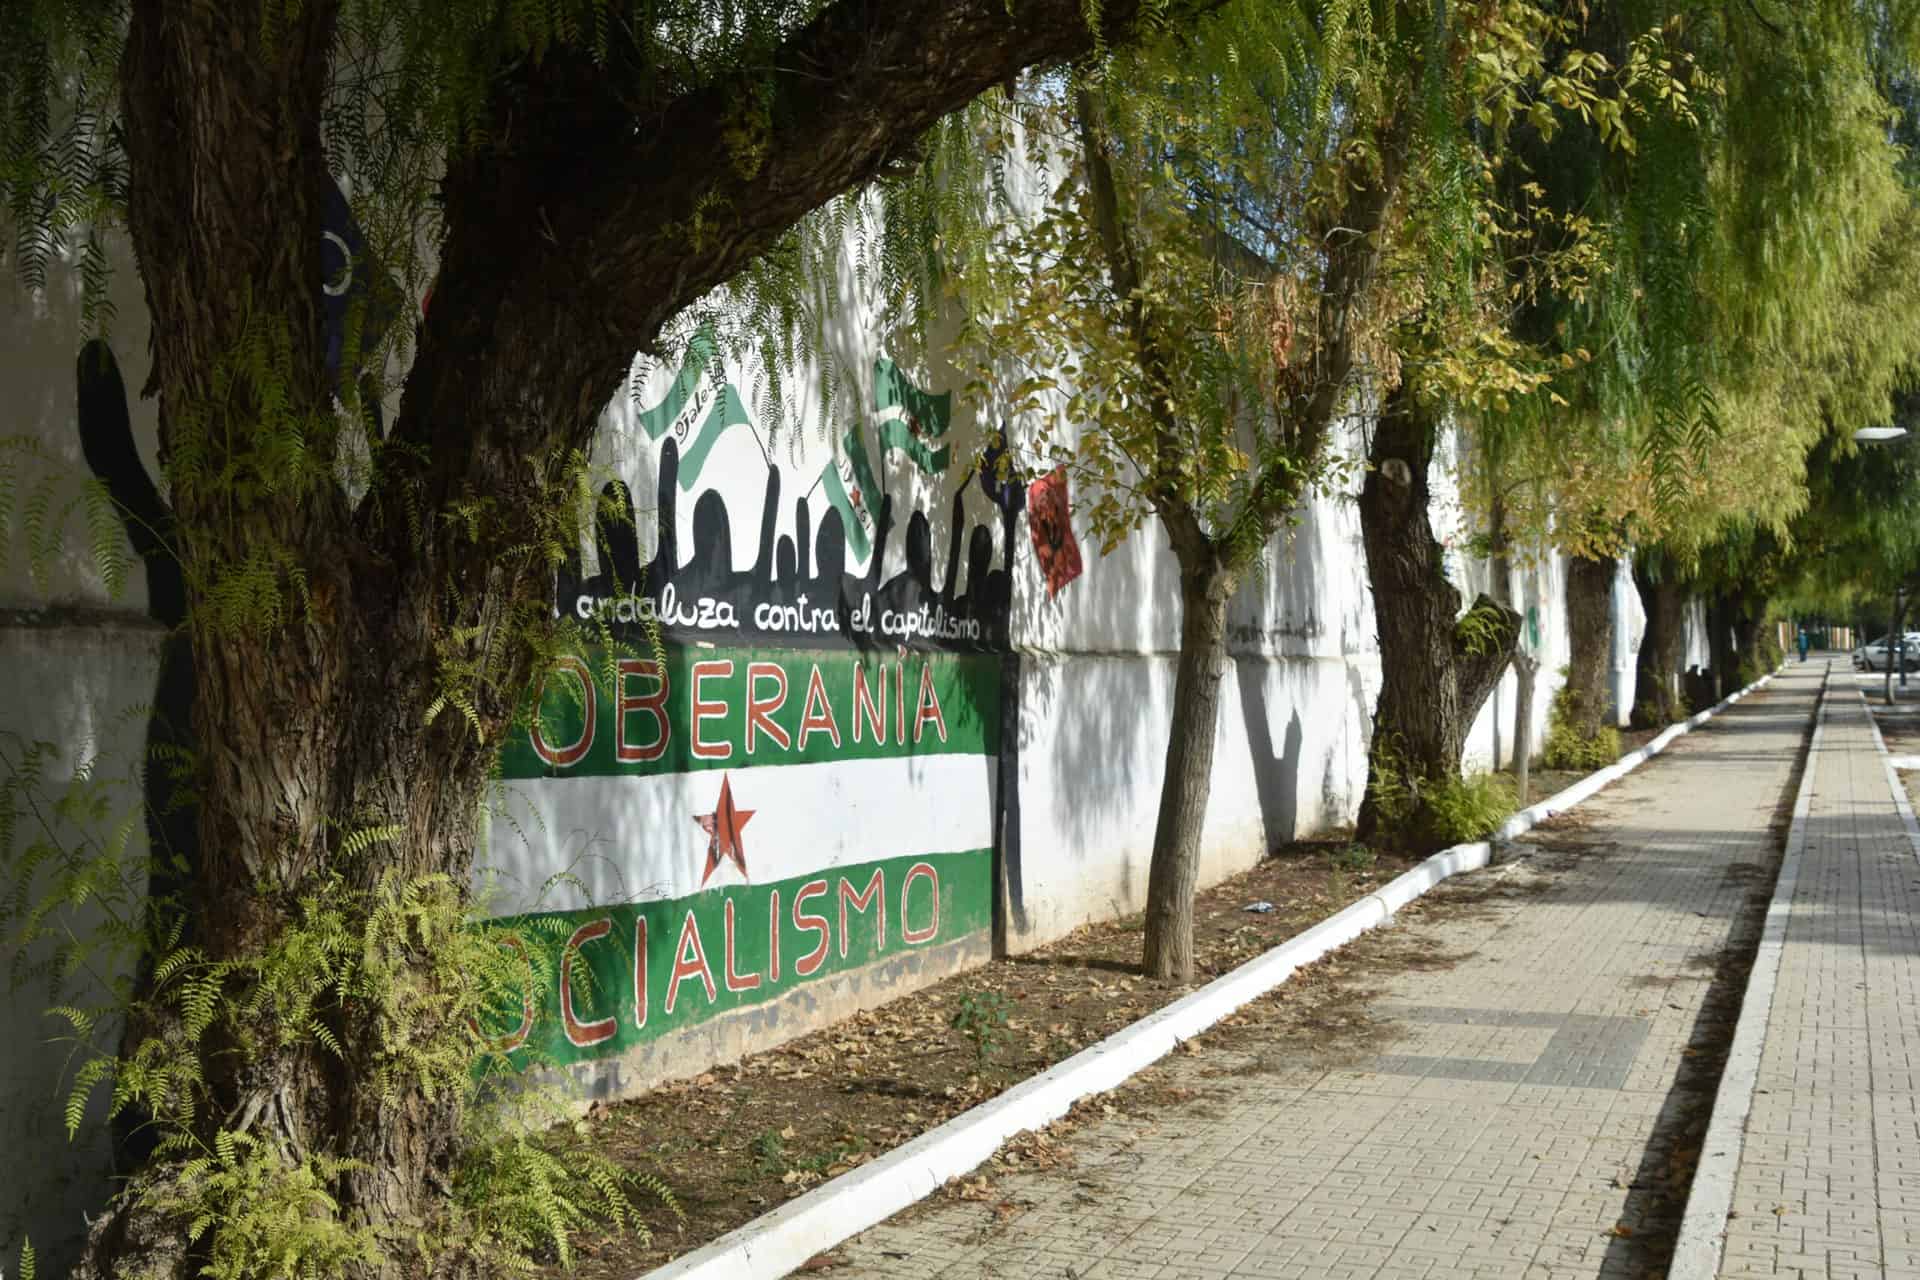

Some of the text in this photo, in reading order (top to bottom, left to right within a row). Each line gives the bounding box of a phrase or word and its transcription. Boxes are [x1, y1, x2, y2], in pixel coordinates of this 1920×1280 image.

[576, 582, 740, 629] andaluza
[754, 592, 840, 633] contra
[850, 592, 874, 633] el
[881, 601, 981, 641] capitalismo
[529, 644, 947, 768] OBERANÍA
[466, 862, 940, 1054] OCIALISMO
